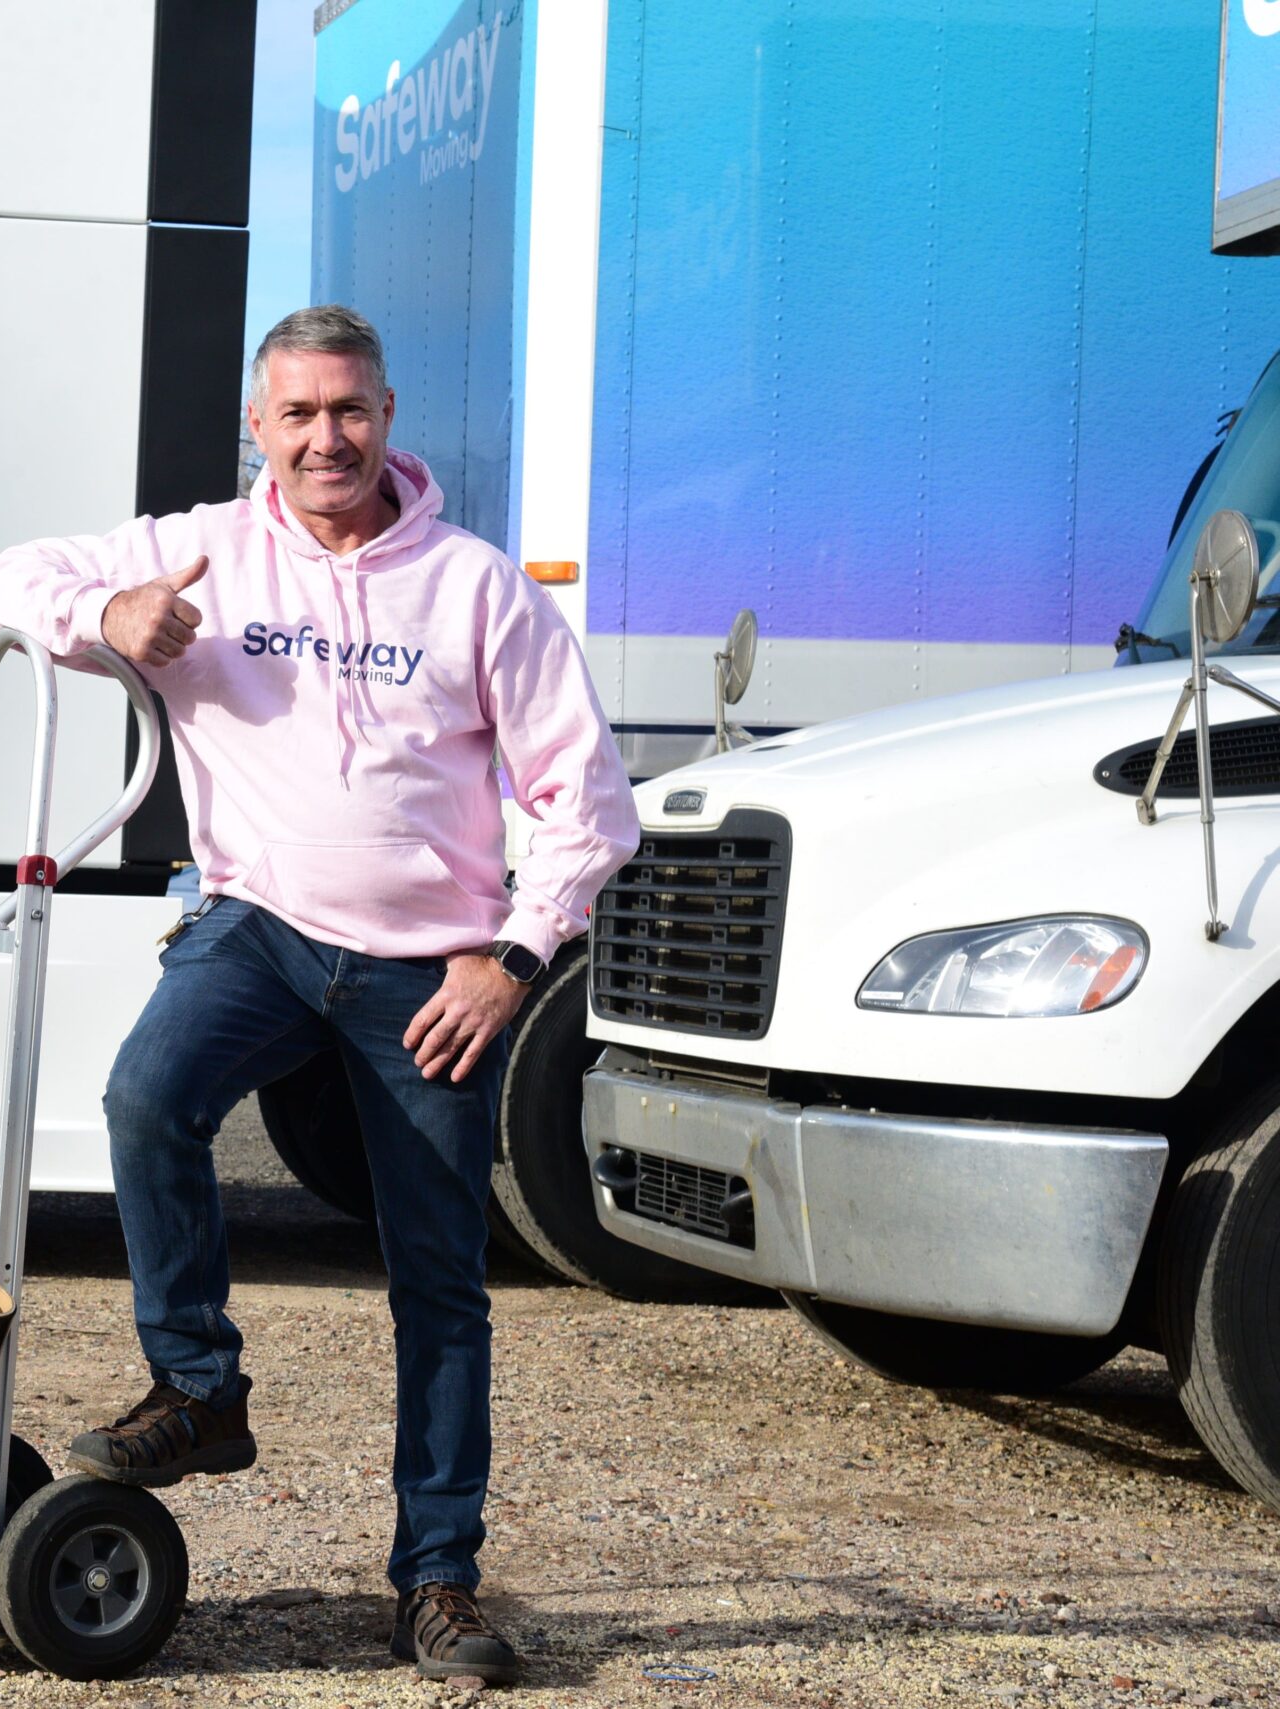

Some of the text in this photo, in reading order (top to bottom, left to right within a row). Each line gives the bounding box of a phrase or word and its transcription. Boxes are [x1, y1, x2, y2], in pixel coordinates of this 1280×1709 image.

[335, 10, 502, 193] Safeway
[420, 130, 469, 185] Moving
[242, 621, 424, 686] Safeway
[337, 668, 393, 686] Moving
